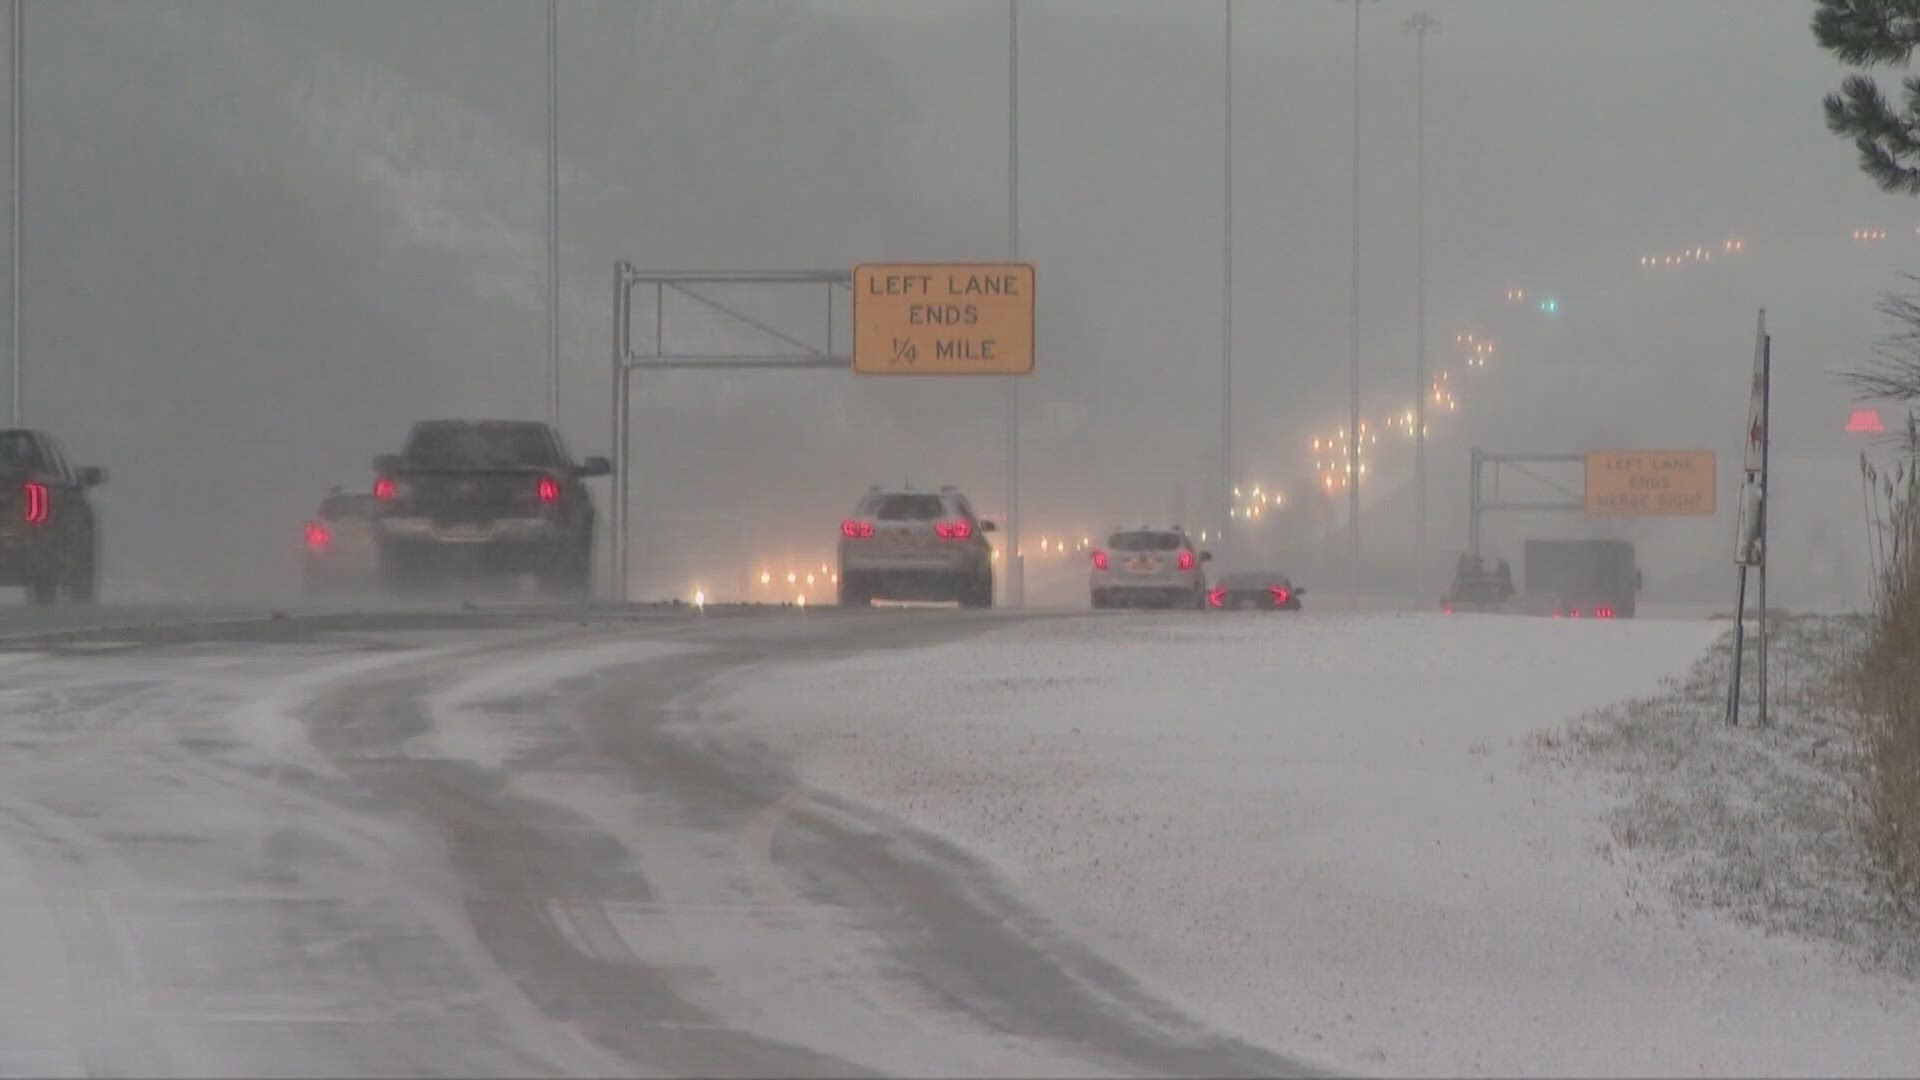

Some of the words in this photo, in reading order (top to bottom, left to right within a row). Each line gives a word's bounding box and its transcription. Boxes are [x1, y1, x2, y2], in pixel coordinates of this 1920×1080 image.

[869, 275, 932, 296] LEFT
[948, 275, 1018, 296] LANE
[909, 305, 979, 326] ENDS
[935, 339, 996, 360] MILE
